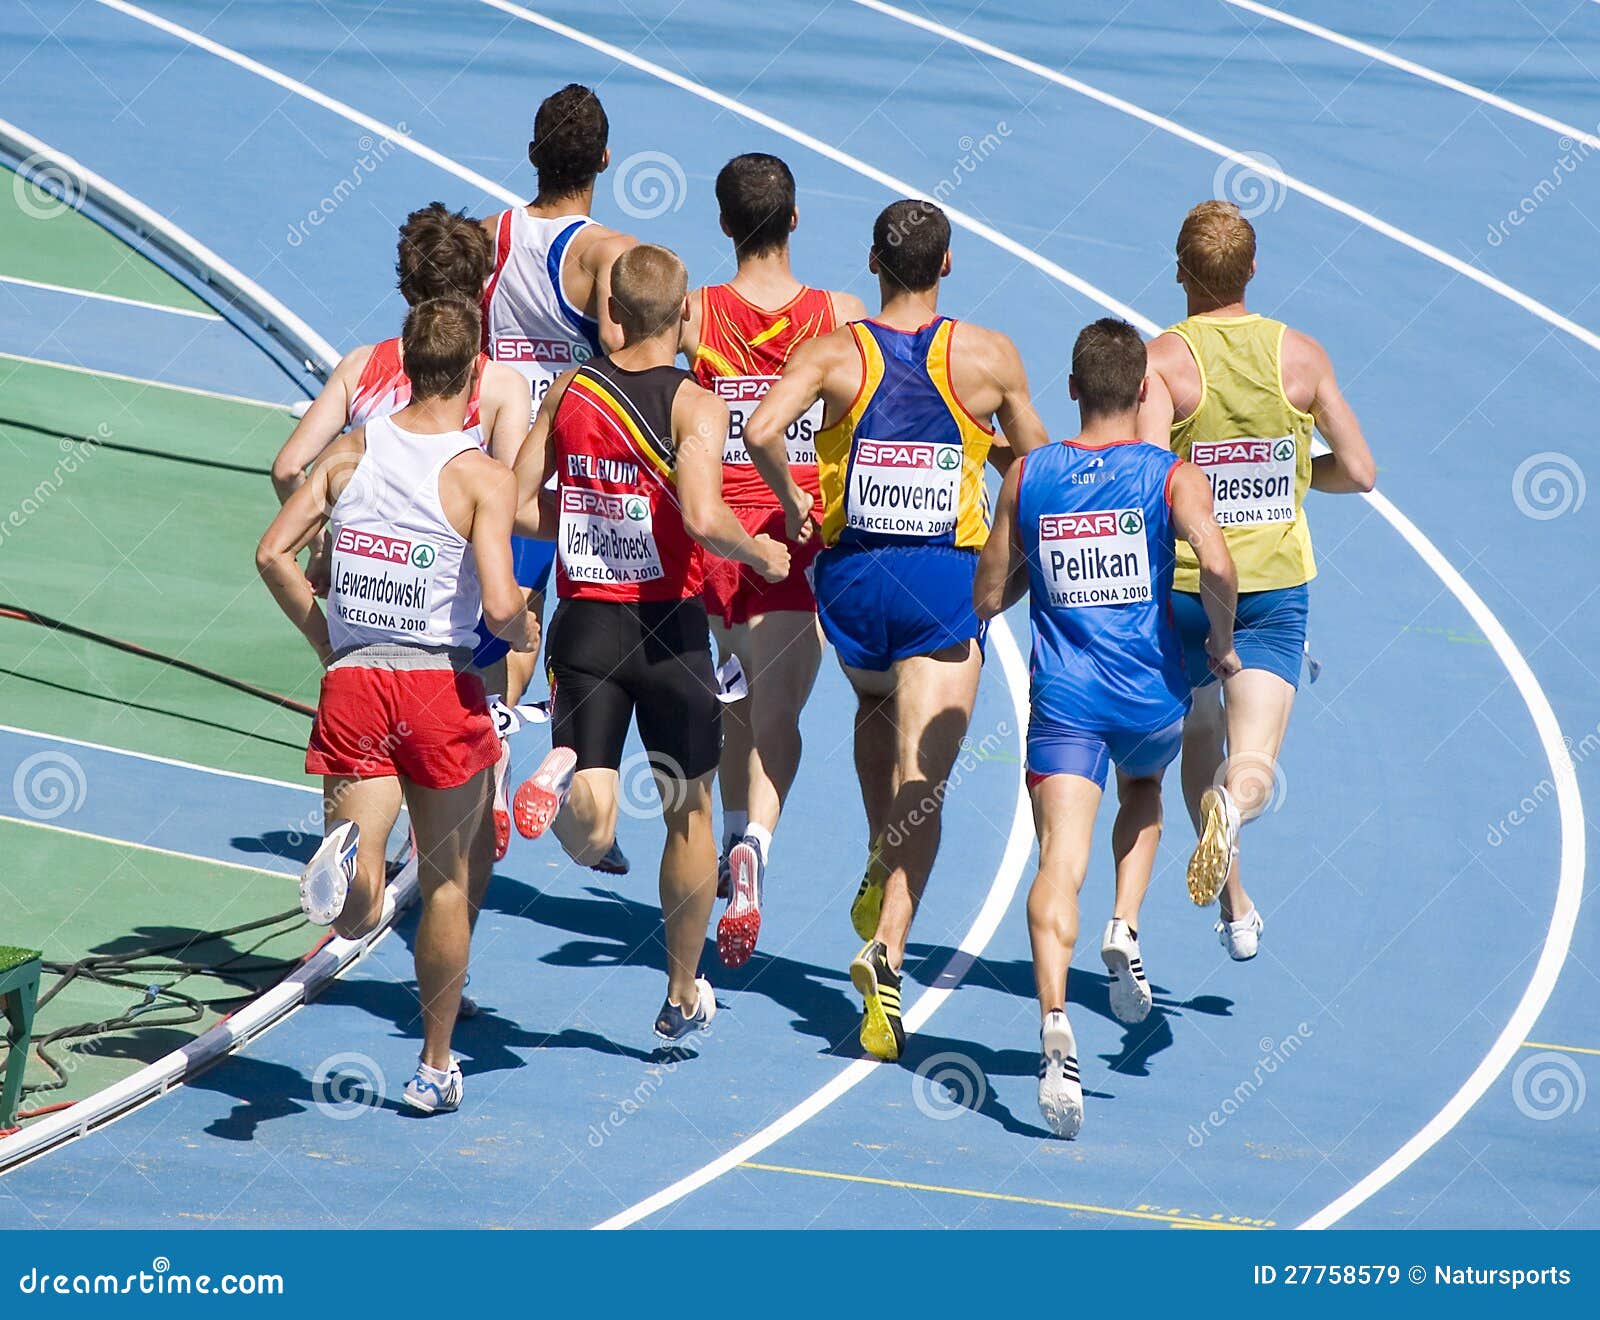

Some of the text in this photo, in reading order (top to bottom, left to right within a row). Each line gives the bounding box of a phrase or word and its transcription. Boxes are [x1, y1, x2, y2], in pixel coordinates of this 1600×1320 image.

[498, 341, 569, 360] SPAR
[719, 381, 771, 399] SPA
[859, 445, 933, 465] SPAR
[1195, 444, 1269, 464] SPAR
[567, 454, 639, 486] BELGIUM
[858, 474, 953, 512] Vorovenci
[1206, 473, 1290, 501] laesson
[565, 492, 623, 518] SPAR
[1215, 507, 1293, 524] CELONA 2010
[851, 515, 953, 534] BARCELONA 2010
[1042, 515, 1116, 538] SPAR
[338, 531, 408, 562] SPAR
[567, 523, 589, 555] Van
[567, 565, 660, 581] ARCELONA 2010
[1050, 548, 1139, 582] Pelikan
[335, 561, 427, 609] Lewandowski
[1051, 585, 1148, 604] BARCELONA 2010
[338, 604, 427, 632] ARCELONA 2010
